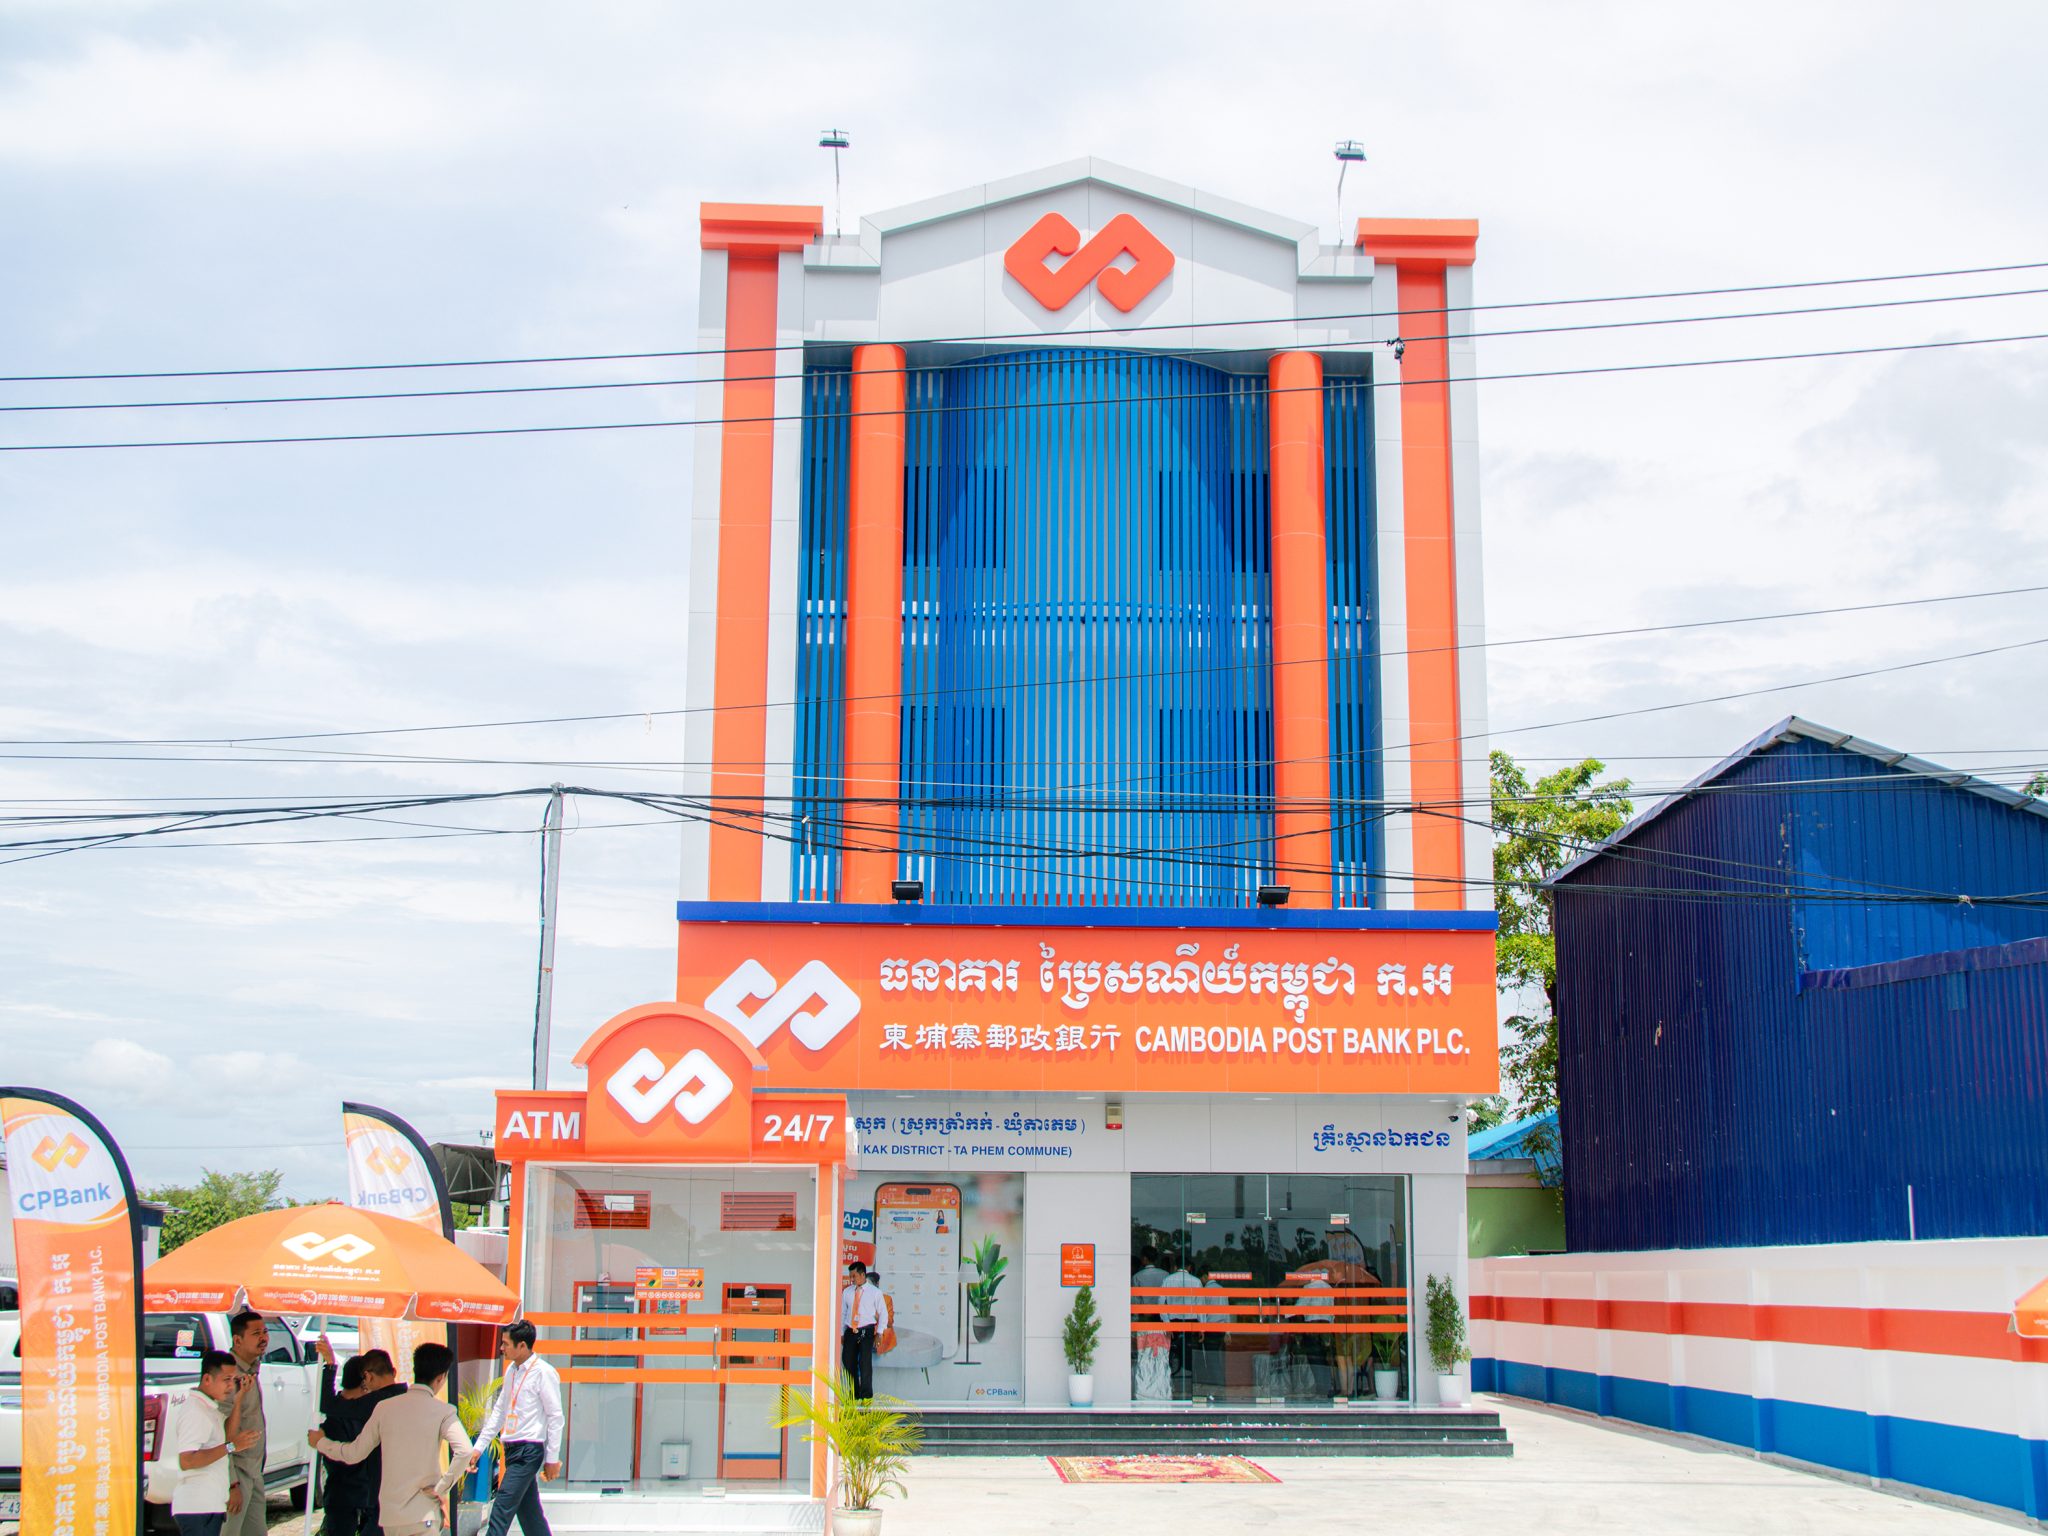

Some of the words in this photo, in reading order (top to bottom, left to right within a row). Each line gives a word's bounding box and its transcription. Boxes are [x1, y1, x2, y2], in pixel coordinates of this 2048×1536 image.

[880, 958, 1020, 993] ធនាគារ
[880, 1023, 1121, 1051] 柬埔寨郵政銀行
[1135, 1026, 1266, 1053] CAMBODIA
[1272, 1027, 1337, 1054] POST
[1344, 1028, 1412, 1054] BANK
[1417, 1028, 1470, 1055] PLC.
[502, 1111, 580, 1140] ATM
[763, 1114, 835, 1143] 24/7
[863, 1144, 888, 1154] KAK
[891, 1145, 944, 1155] DISTRICT
[954, 1145, 968, 1155] TA
[971, 1146, 1004, 1156] PHEM
[1008, 1146, 1072, 1158] COMMUNE)
[19, 1182, 111, 1212] CPBank
[844, 1213, 869, 1229] App
[91, 1246, 103, 1274] PLC.
[93, 1276, 106, 1312] BANK
[95, 1315, 108, 1348] POST
[97, 1351, 110, 1420] CAMBODIA
[986, 1388, 1018, 1396] CPBank
